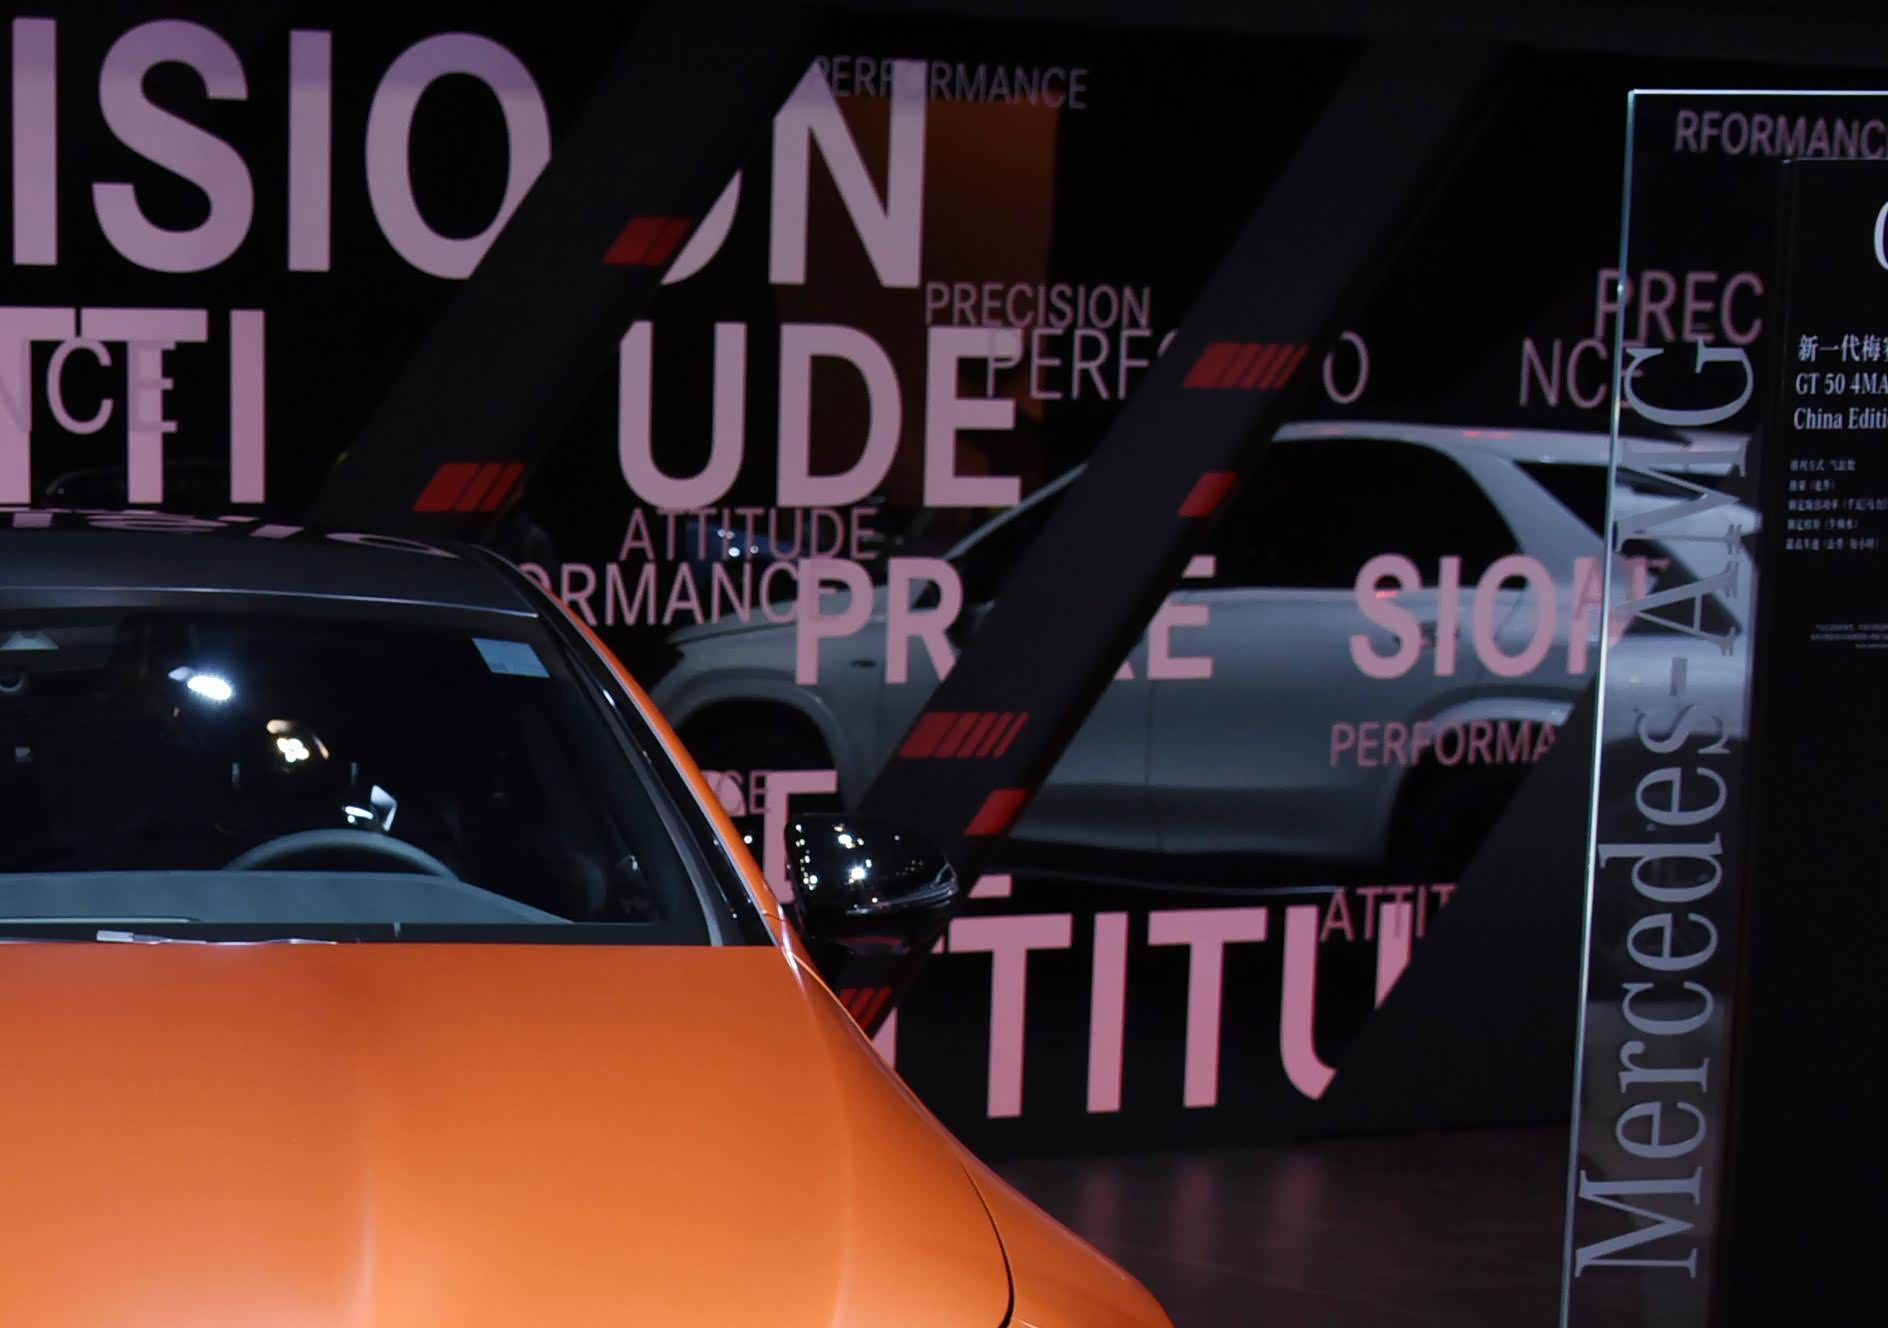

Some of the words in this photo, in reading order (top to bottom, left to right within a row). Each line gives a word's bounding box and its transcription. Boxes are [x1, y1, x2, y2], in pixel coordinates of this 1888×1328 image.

[813, 55, 1089, 110] PERFRMANCE
[925, 282, 1152, 331] PRECISION
[986, 327, 1178, 400] PERF
[1798, 334, 1888, 362] 新一代梅
[1795, 372, 1821, 395] GT
[1824, 372, 1845, 395] 50
[1794, 407, 1843, 430] China
[1848, 407, 1888, 430] Editi
[618, 507, 880, 562] ATTITUDE
[1575, 340, 1754, 1279] Mercedes-AMG
